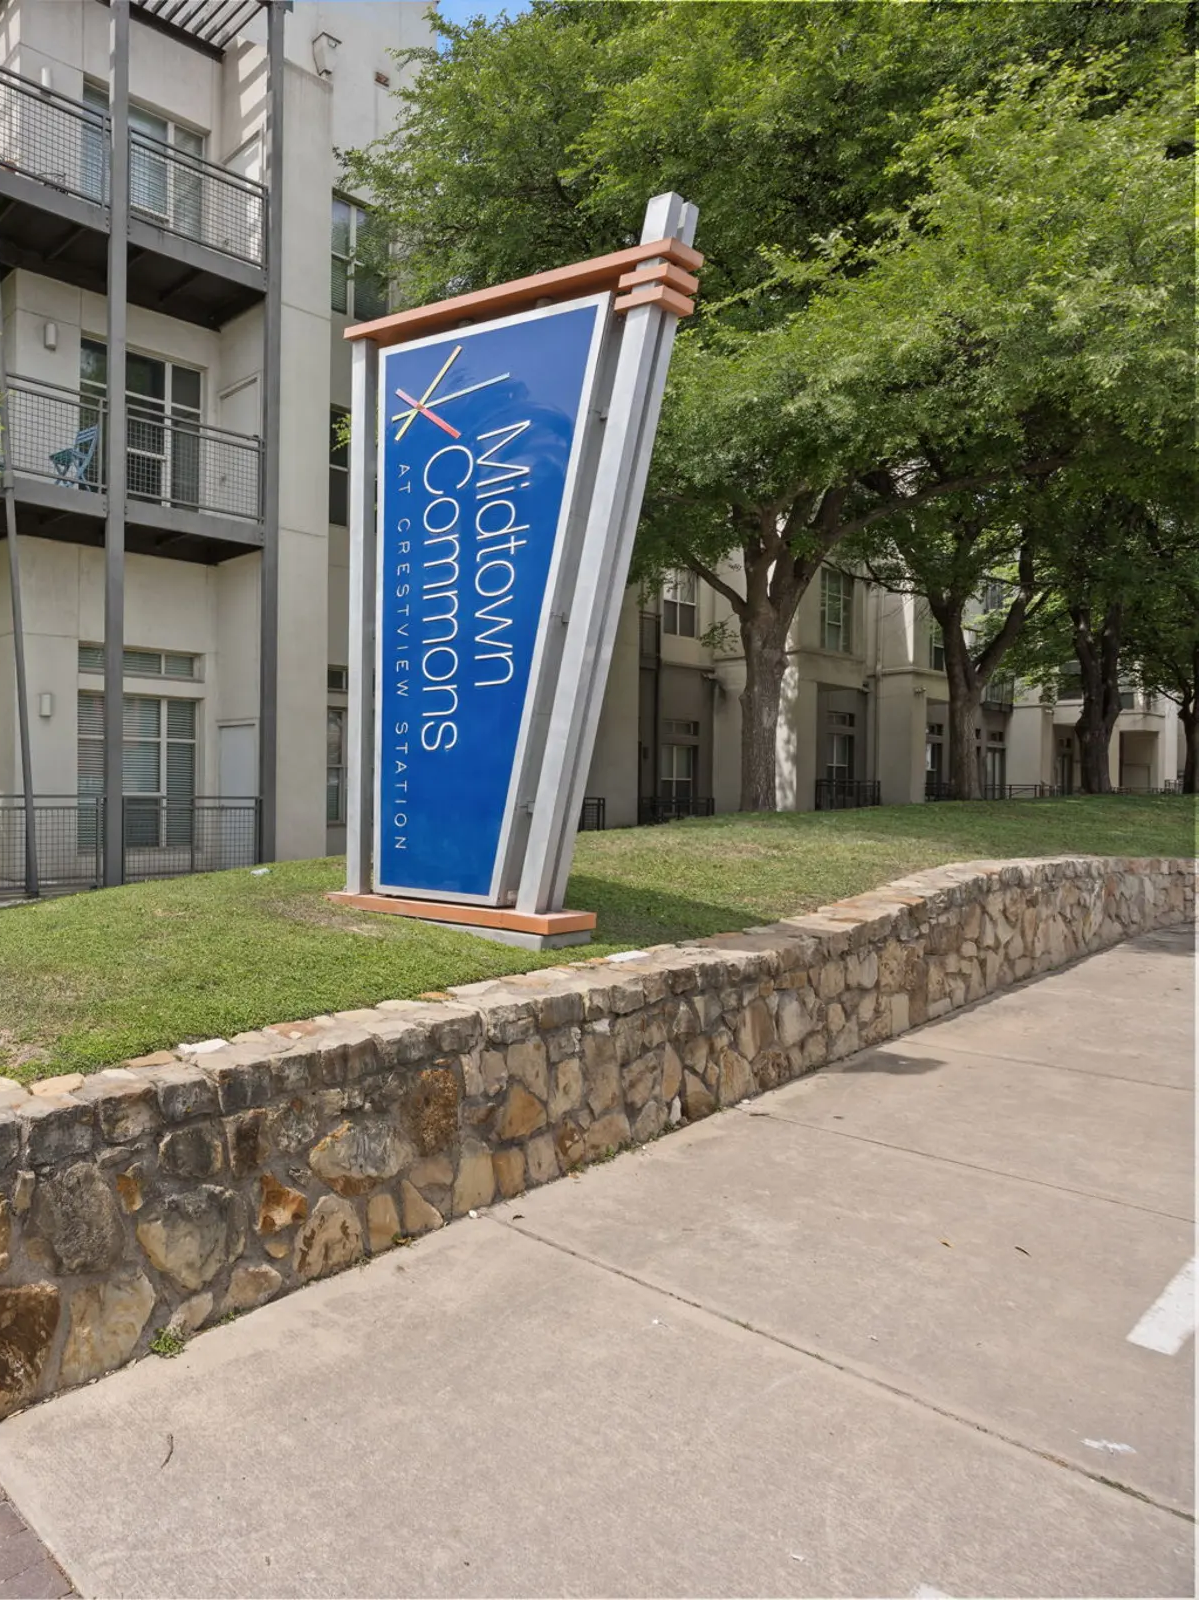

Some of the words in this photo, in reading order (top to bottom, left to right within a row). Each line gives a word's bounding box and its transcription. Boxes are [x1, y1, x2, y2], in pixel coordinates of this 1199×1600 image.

[397, 463, 411, 494] AT
[474, 420, 532, 687] Midtown
[395, 518, 411, 697] CRESTVIEW
[421, 444, 473, 751] Commons
[393, 722, 409, 851] STATION
